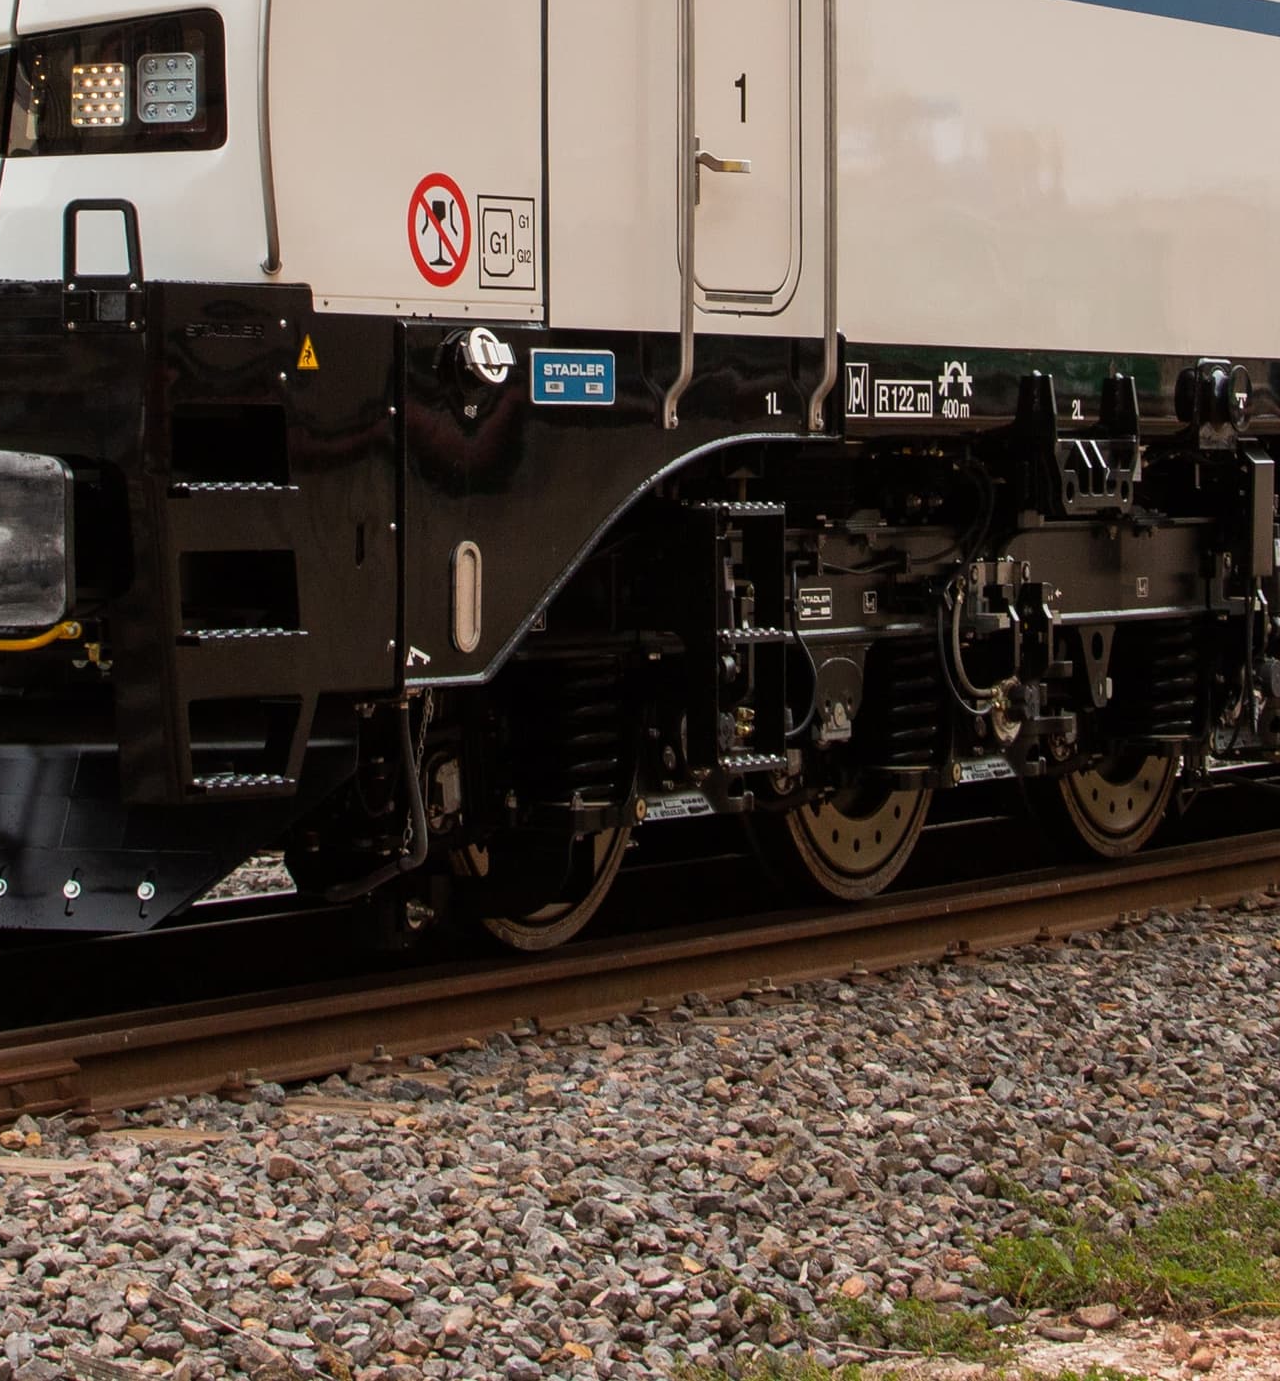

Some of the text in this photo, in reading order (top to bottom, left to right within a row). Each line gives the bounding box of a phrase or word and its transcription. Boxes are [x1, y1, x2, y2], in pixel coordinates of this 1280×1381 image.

[734, 73, 746, 124] 1
[518, 214, 530, 229] G1
[490, 231, 508, 255] G1
[185, 324, 264, 339] STADLER
[543, 363, 605, 377] STADLER
[765, 392, 782, 415] 1L
[879, 385, 930, 412] R 122 m
[941, 399, 970, 418] 400 m
[1072, 399, 1084, 420] 2L
